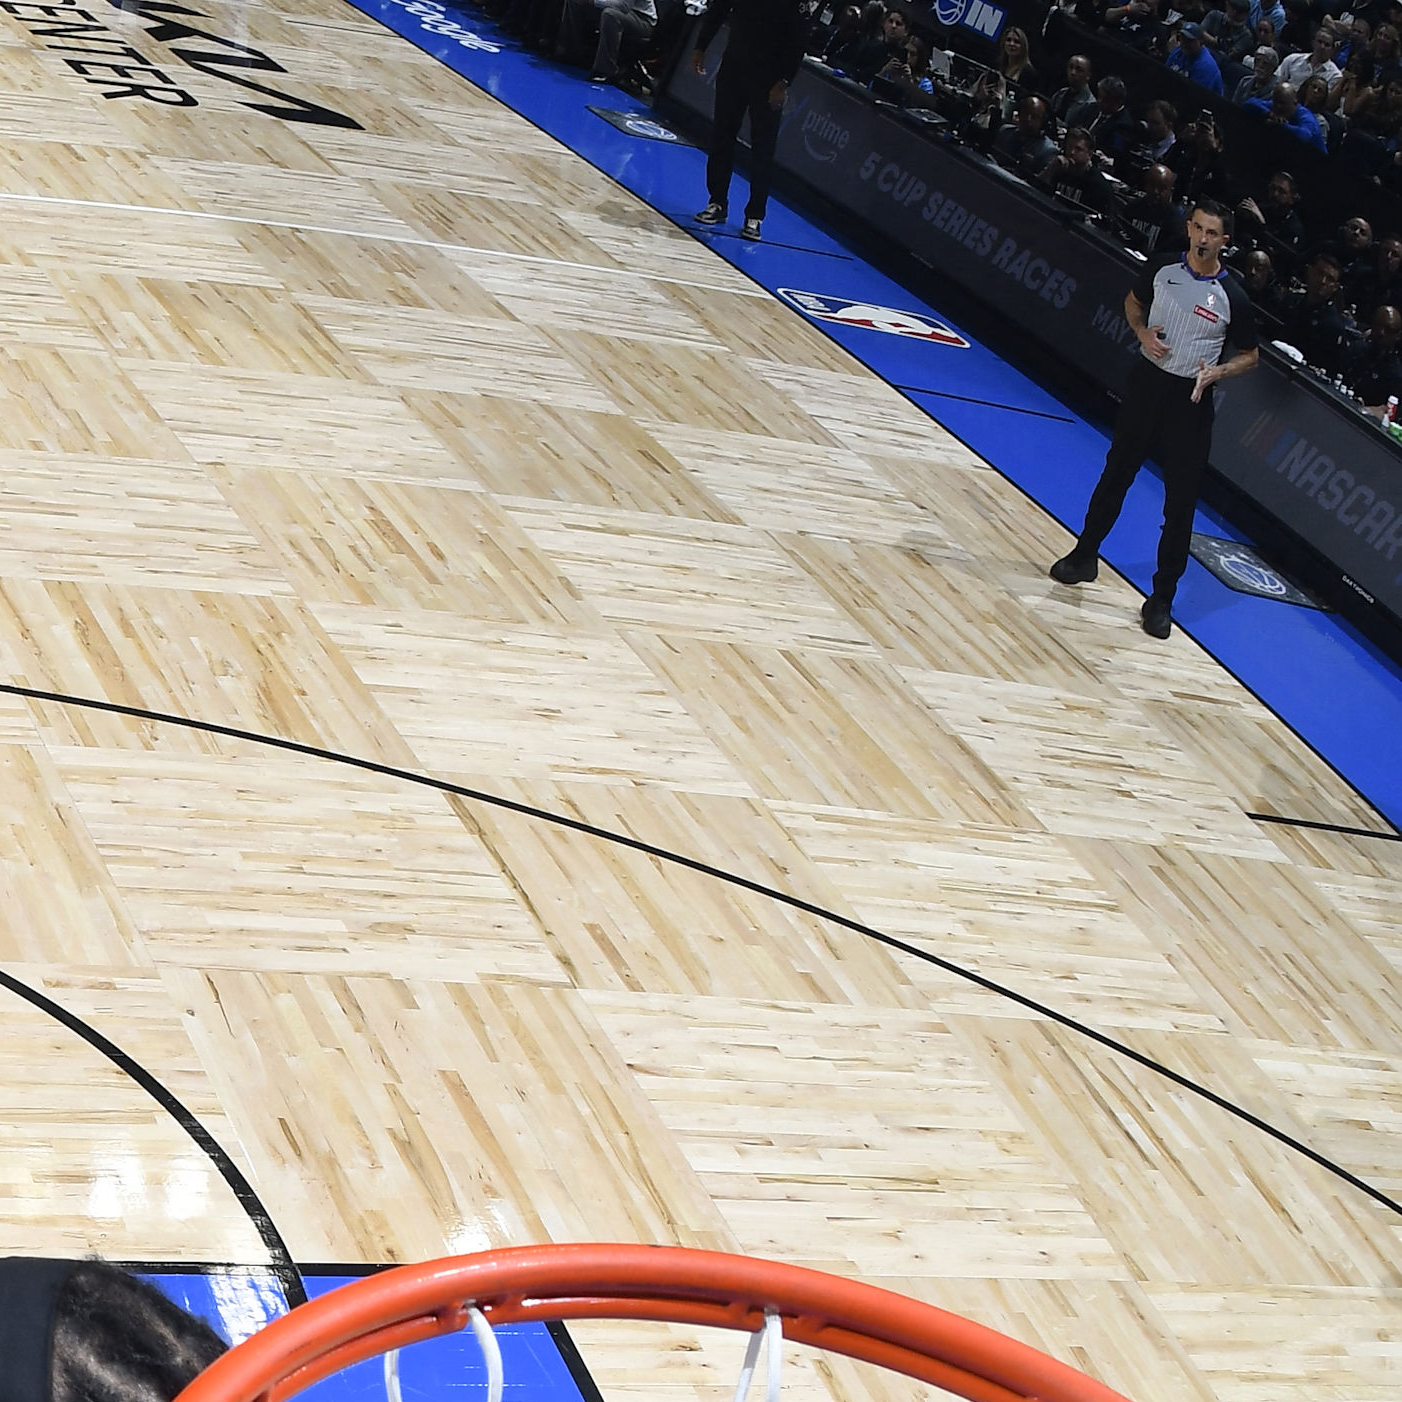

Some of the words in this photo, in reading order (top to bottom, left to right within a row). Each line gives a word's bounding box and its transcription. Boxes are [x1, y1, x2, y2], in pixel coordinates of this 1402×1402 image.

[964, 0, 1003, 37] IN
[802, 109, 850, 150] prime
[859, 151, 884, 181] 5
[877, 163, 928, 206] CUP
[922, 192, 999, 256] SERIES
[990, 237, 1077, 309] RACES
[1092, 304, 1131, 344] MAY
[1276, 438, 1402, 561] NASCAR
